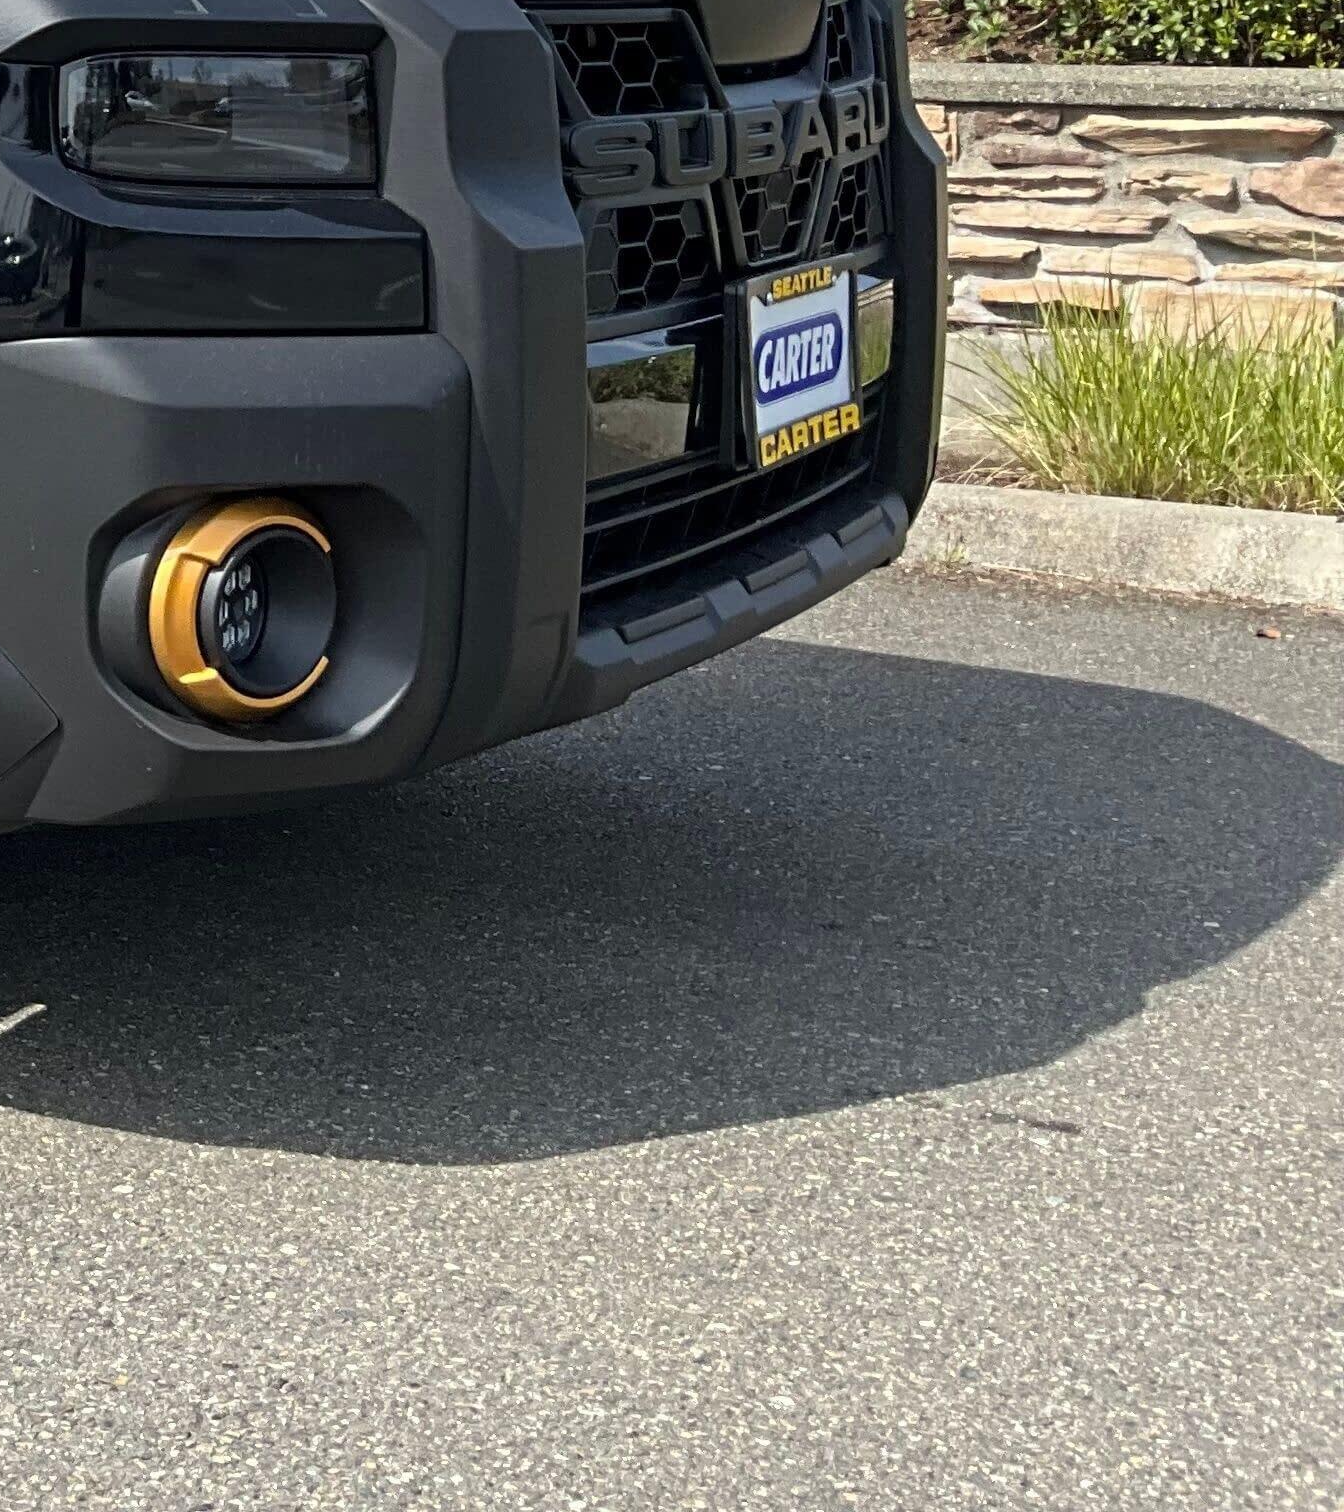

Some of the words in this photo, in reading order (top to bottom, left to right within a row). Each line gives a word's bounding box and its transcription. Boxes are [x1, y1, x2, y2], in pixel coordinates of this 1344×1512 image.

[569, 80, 890, 196] SUBARU
[771, 265, 833, 302] SEATTLE
[758, 322, 836, 394] CARTER
[760, 402, 861, 468] CARTER
